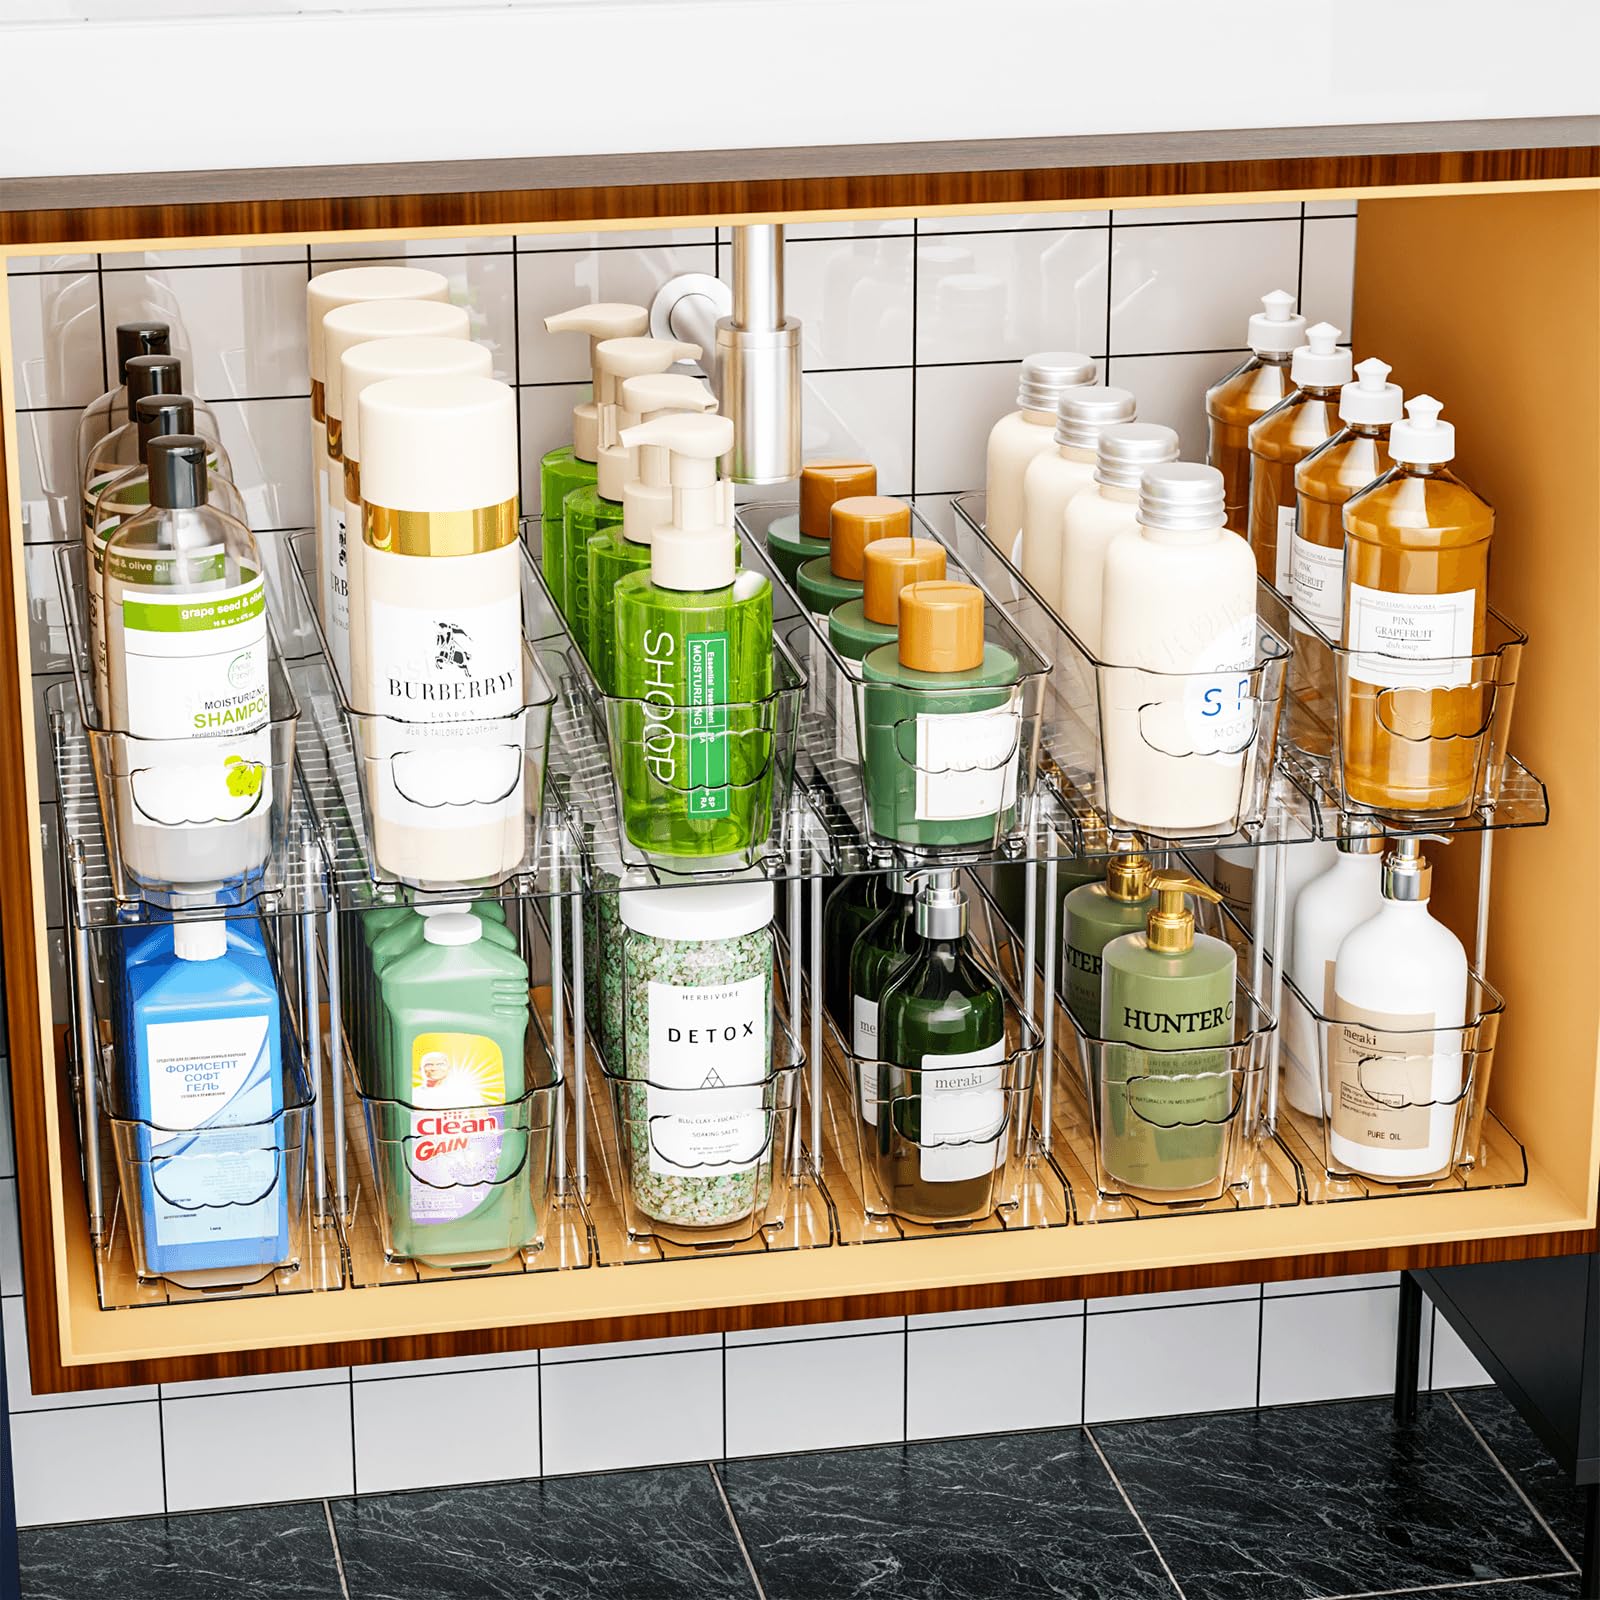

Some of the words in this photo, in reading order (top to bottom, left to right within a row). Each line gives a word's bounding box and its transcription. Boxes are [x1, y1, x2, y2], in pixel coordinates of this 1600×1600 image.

[129, 561, 152, 571] olive
[155, 563, 169, 572] oil
[181, 607, 214, 620] grape
[217, 600, 241, 613] seed
[242, 597, 249, 607] &
[1392, 615, 1415, 626] PINK
[1375, 626, 1433, 639] GRAPEFRUIT
[388, 671, 514, 700] BURBERRY
[692, 644, 703, 726] MOISTURIZING
[431, 710, 475, 718] LONDON
[643, 629, 675, 783] SHOOP
[708, 796, 716, 808] SP
[1064, 940, 1103, 976] NTER
[682, 991, 740, 1001] HERBIVORE
[1123, 1007, 1224, 1034] HUNTER
[668, 1021, 754, 1044] DETOX
[1343, 1027, 1377, 1046] meraki
[165, 1060, 238, 1074] ФОРИСЕПТ
[184, 1072, 220, 1083] СОФТ
[935, 1070, 982, 1088] meraki
[186, 1082, 219, 1093] ГЕЛЬ
[416, 1117, 496, 1136] Clean
[1367, 1130, 1386, 1140] PURE
[1389, 1132, 1402, 1141] OIL
[415, 1137, 468, 1162] GAIN
